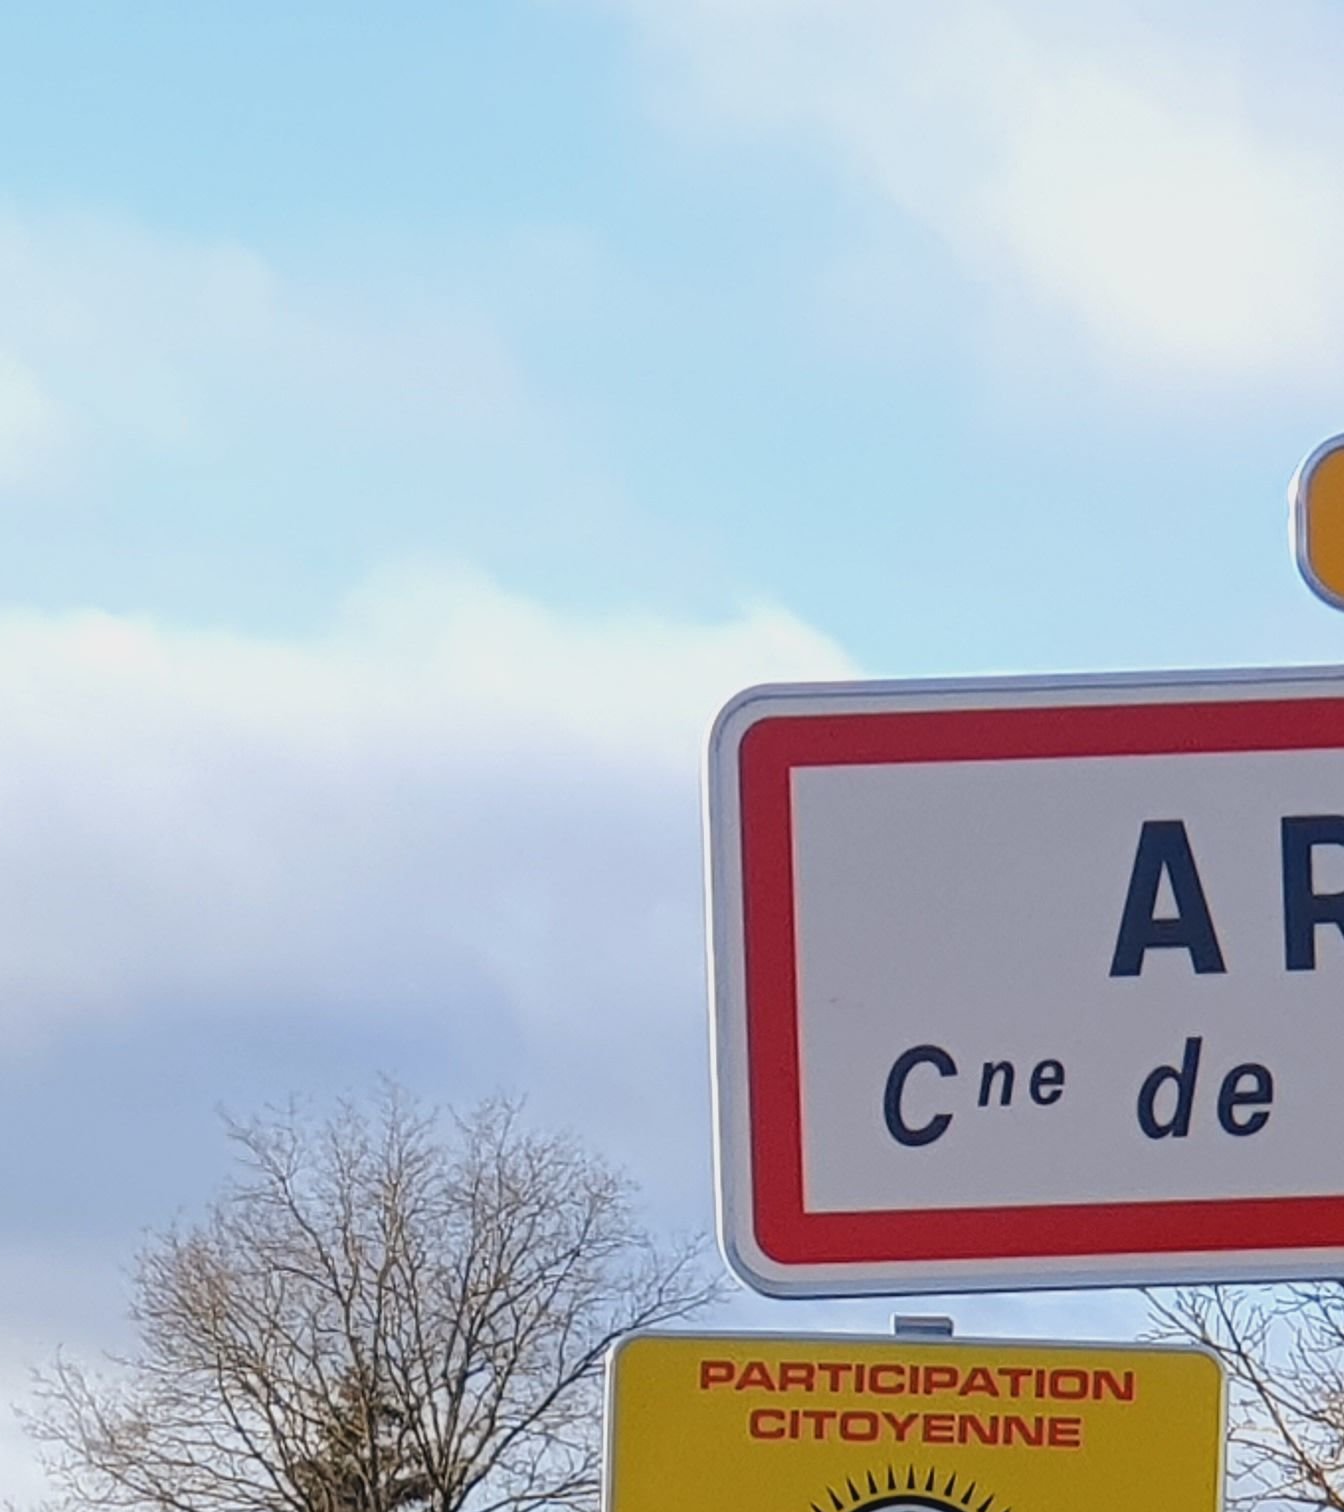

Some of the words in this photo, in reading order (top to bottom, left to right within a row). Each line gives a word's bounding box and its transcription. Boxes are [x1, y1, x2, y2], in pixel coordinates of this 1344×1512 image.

[883, 1043, 1066, 1148] Cne
[1137, 1036, 1275, 1140] de
[699, 1360, 1135, 1401] PARTICIPATION
[748, 1409, 1082, 1448] CITOYENNE
